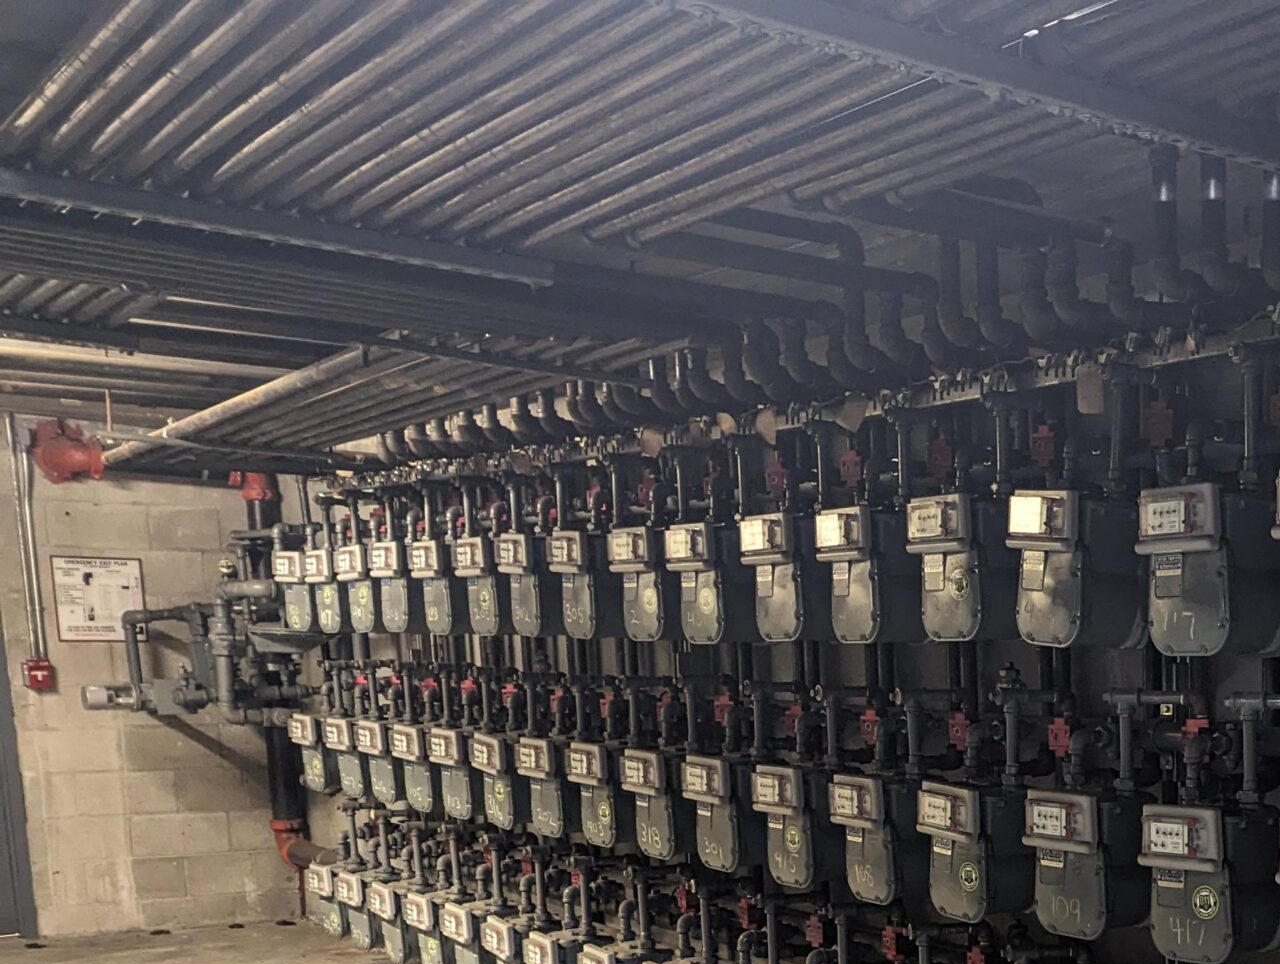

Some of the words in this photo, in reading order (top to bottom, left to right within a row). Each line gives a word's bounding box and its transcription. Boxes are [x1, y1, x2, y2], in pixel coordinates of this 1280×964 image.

[565, 603, 584, 624] 305
[640, 822, 662, 849] 318
[774, 851, 800, 873] 415
[1052, 895, 1081, 924] 109
